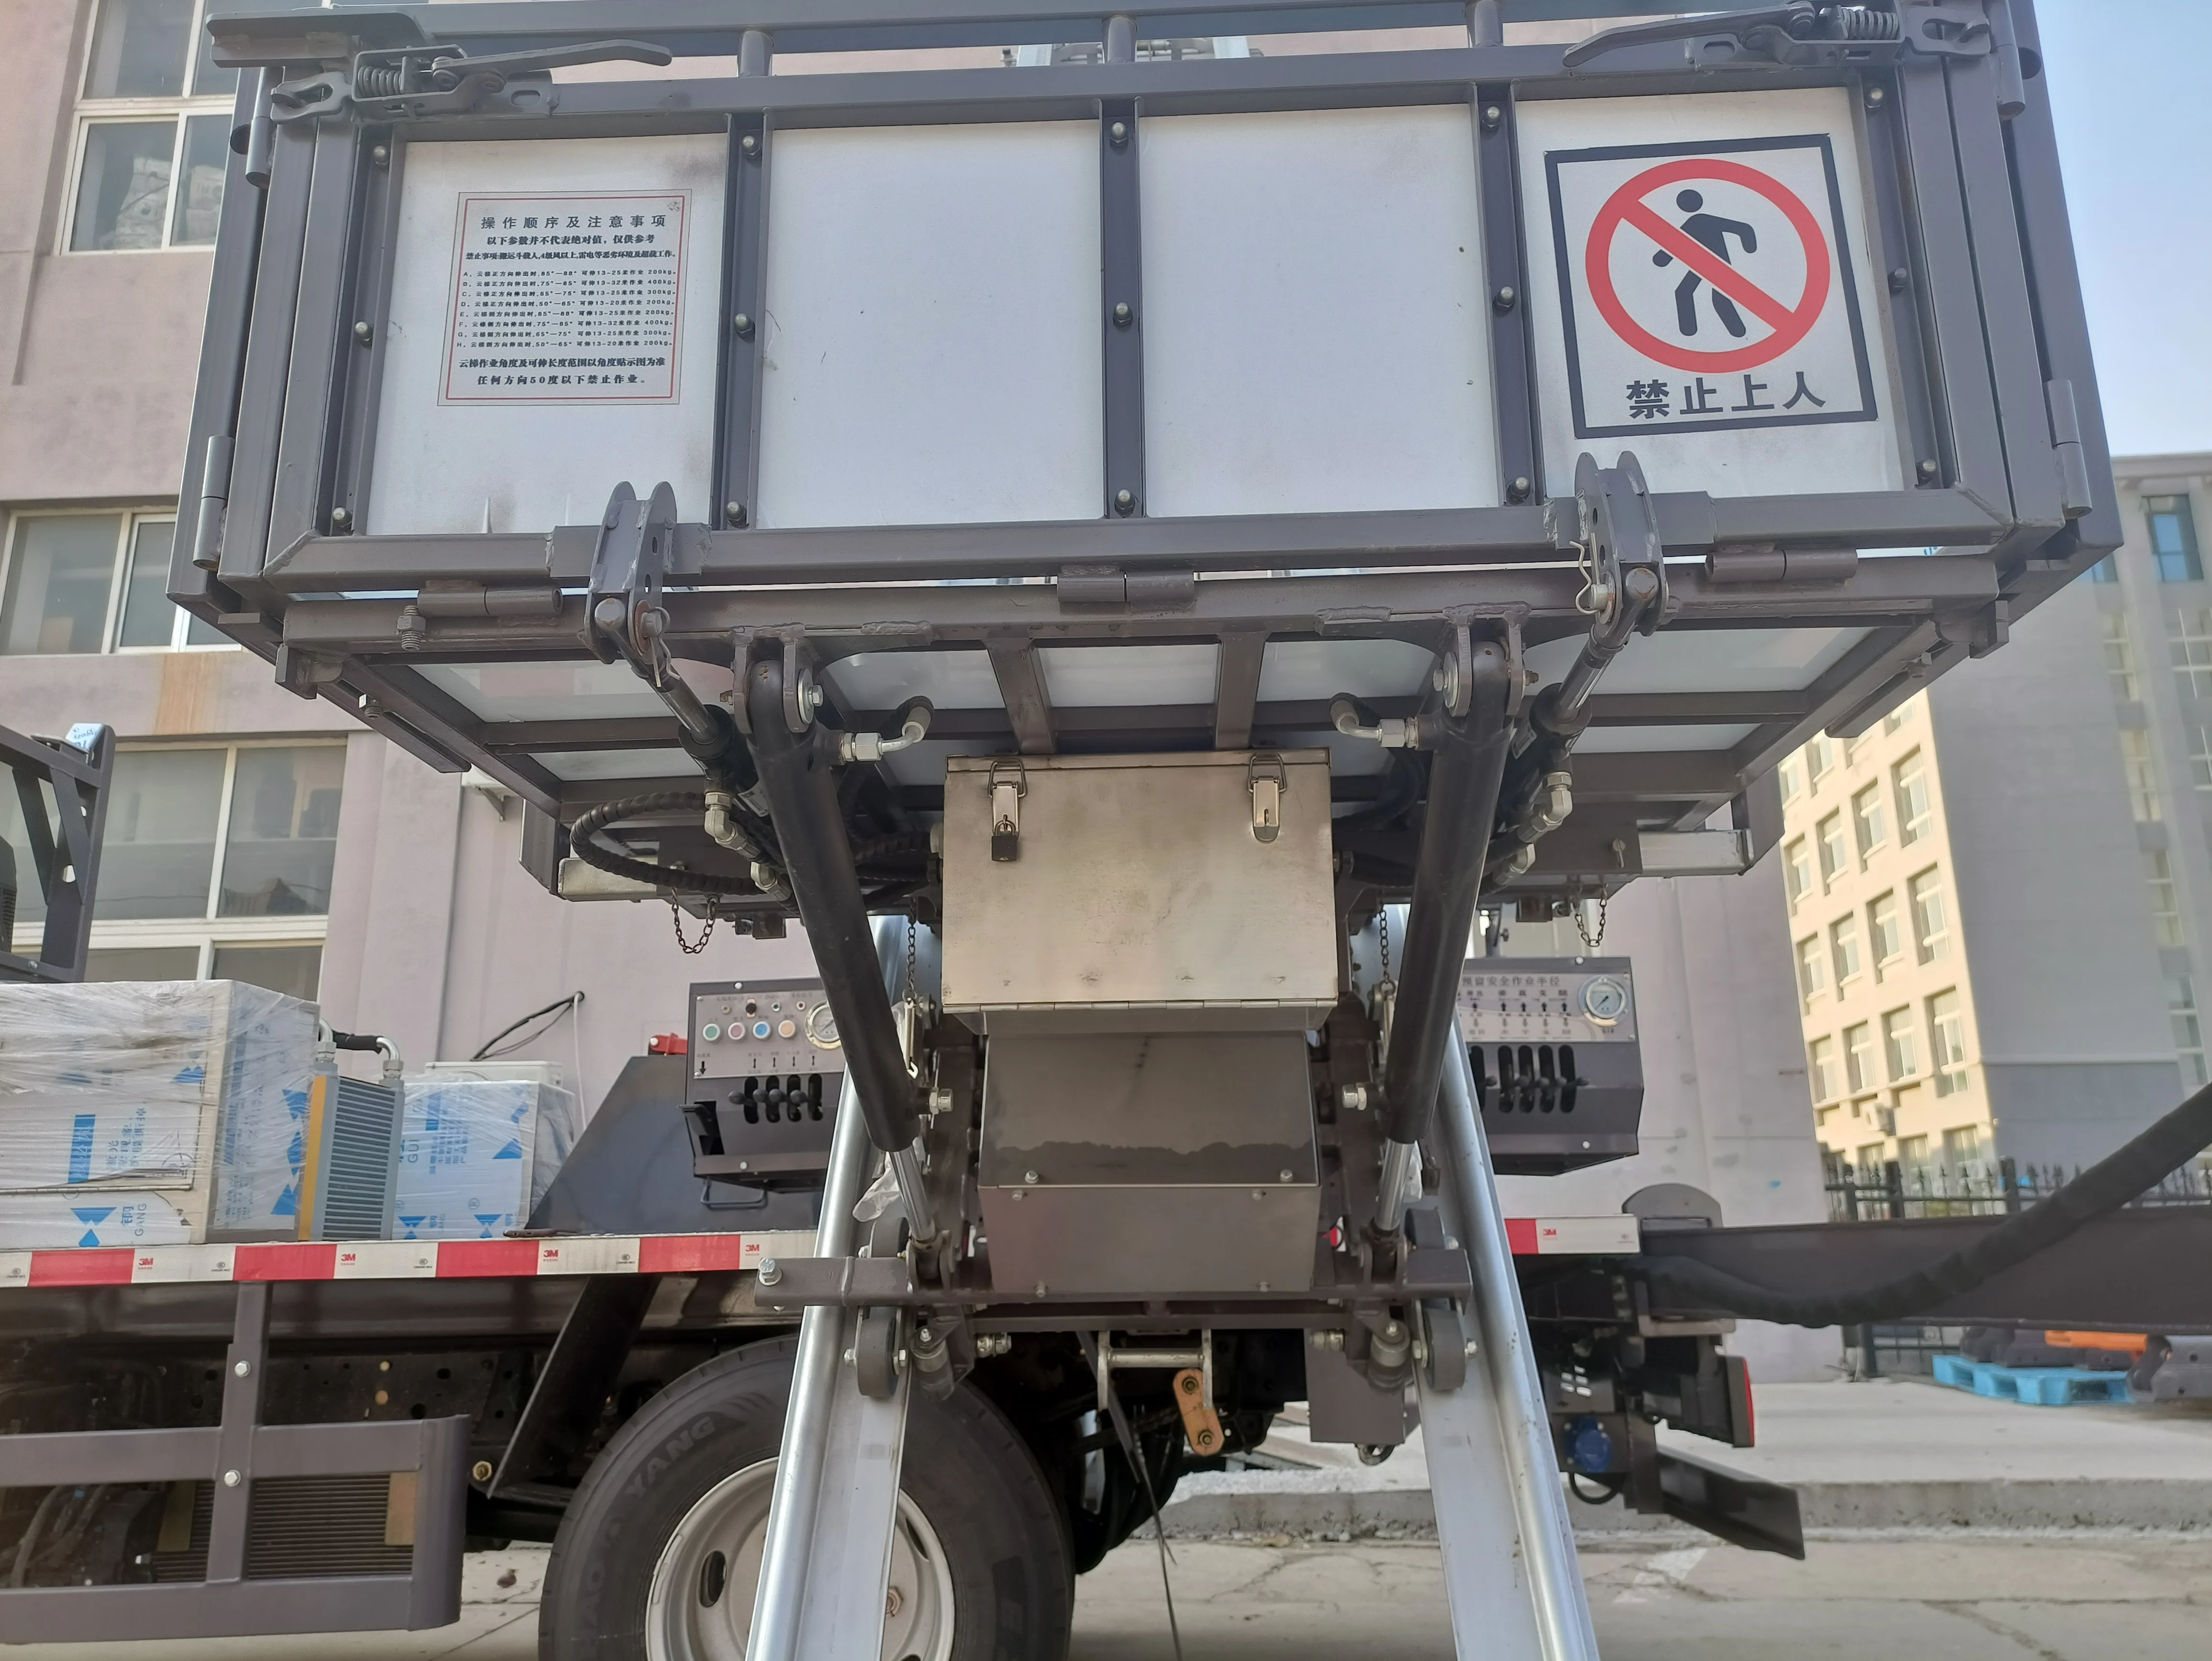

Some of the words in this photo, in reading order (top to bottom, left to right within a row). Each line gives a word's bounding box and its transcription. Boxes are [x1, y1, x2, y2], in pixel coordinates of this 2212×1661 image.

[481, 214, 666, 230] 操作顺序及注意事项
[487, 234, 655, 245] 以下参数并不代表绝对值，仅供参考
[1626, 371, 1827, 420] 禁止上人
[134, 1203, 147, 1237] GANG
[543, 1250, 559, 1258] 3M
[745, 1244, 760, 1252] 3M
[341, 1253, 356, 1262] 3M
[624, 1416, 716, 1498] YANG
